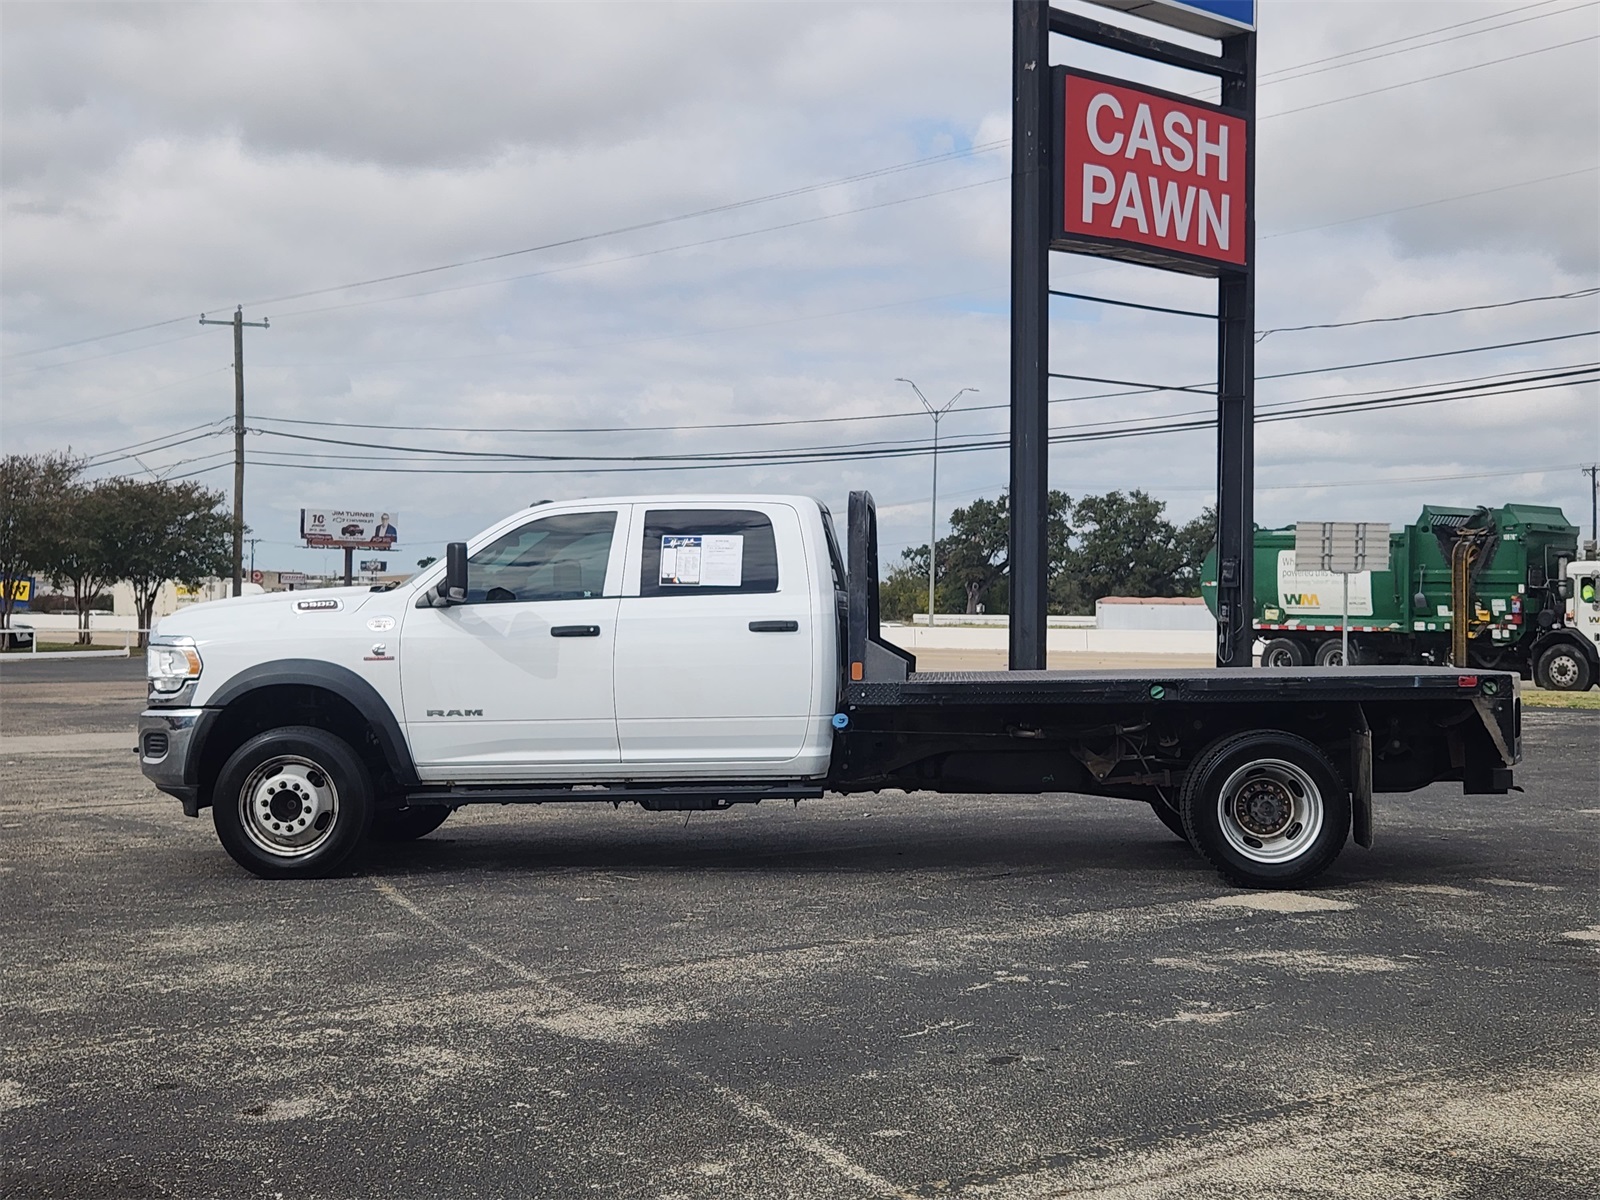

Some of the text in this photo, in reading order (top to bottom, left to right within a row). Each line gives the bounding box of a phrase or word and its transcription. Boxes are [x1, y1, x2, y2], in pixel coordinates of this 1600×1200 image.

[1086, 92, 1229, 182] CASH
[1082, 163, 1230, 251] PAWN
[1283, 593, 1320, 606] WM
[426, 709, 483, 717] RAM
